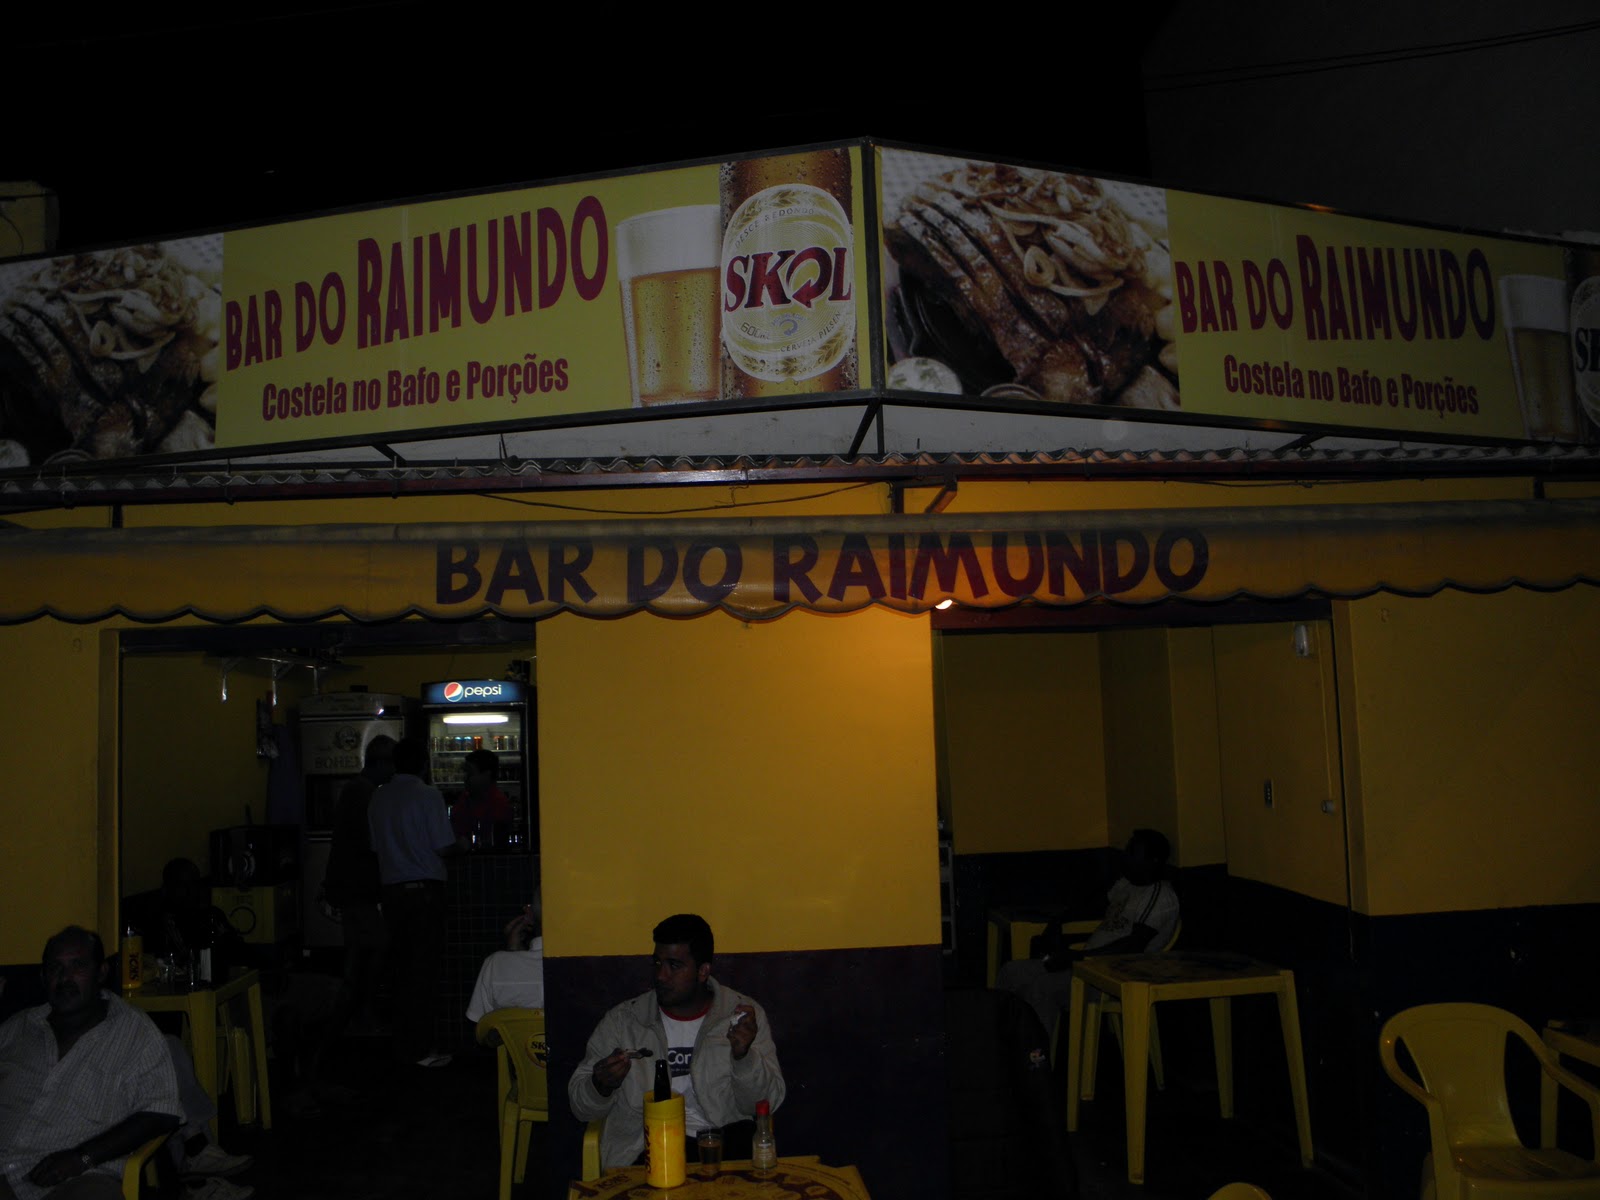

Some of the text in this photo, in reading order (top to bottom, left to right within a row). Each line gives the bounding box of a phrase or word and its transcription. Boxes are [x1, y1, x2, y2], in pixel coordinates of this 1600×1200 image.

[226, 195, 609, 371] BAR DO RAIMUNDO
[724, 246, 852, 313] SKOL
[1174, 234, 1496, 342] BAR DO RAIMUNDO
[262, 353, 569, 422] Costela no Bafo e Porções
[1223, 354, 1479, 419] Costela no Bafo e Porções
[436, 528, 1209, 605] BAR DO RAIMUNDO
[464, 684, 502, 698] pepsi
